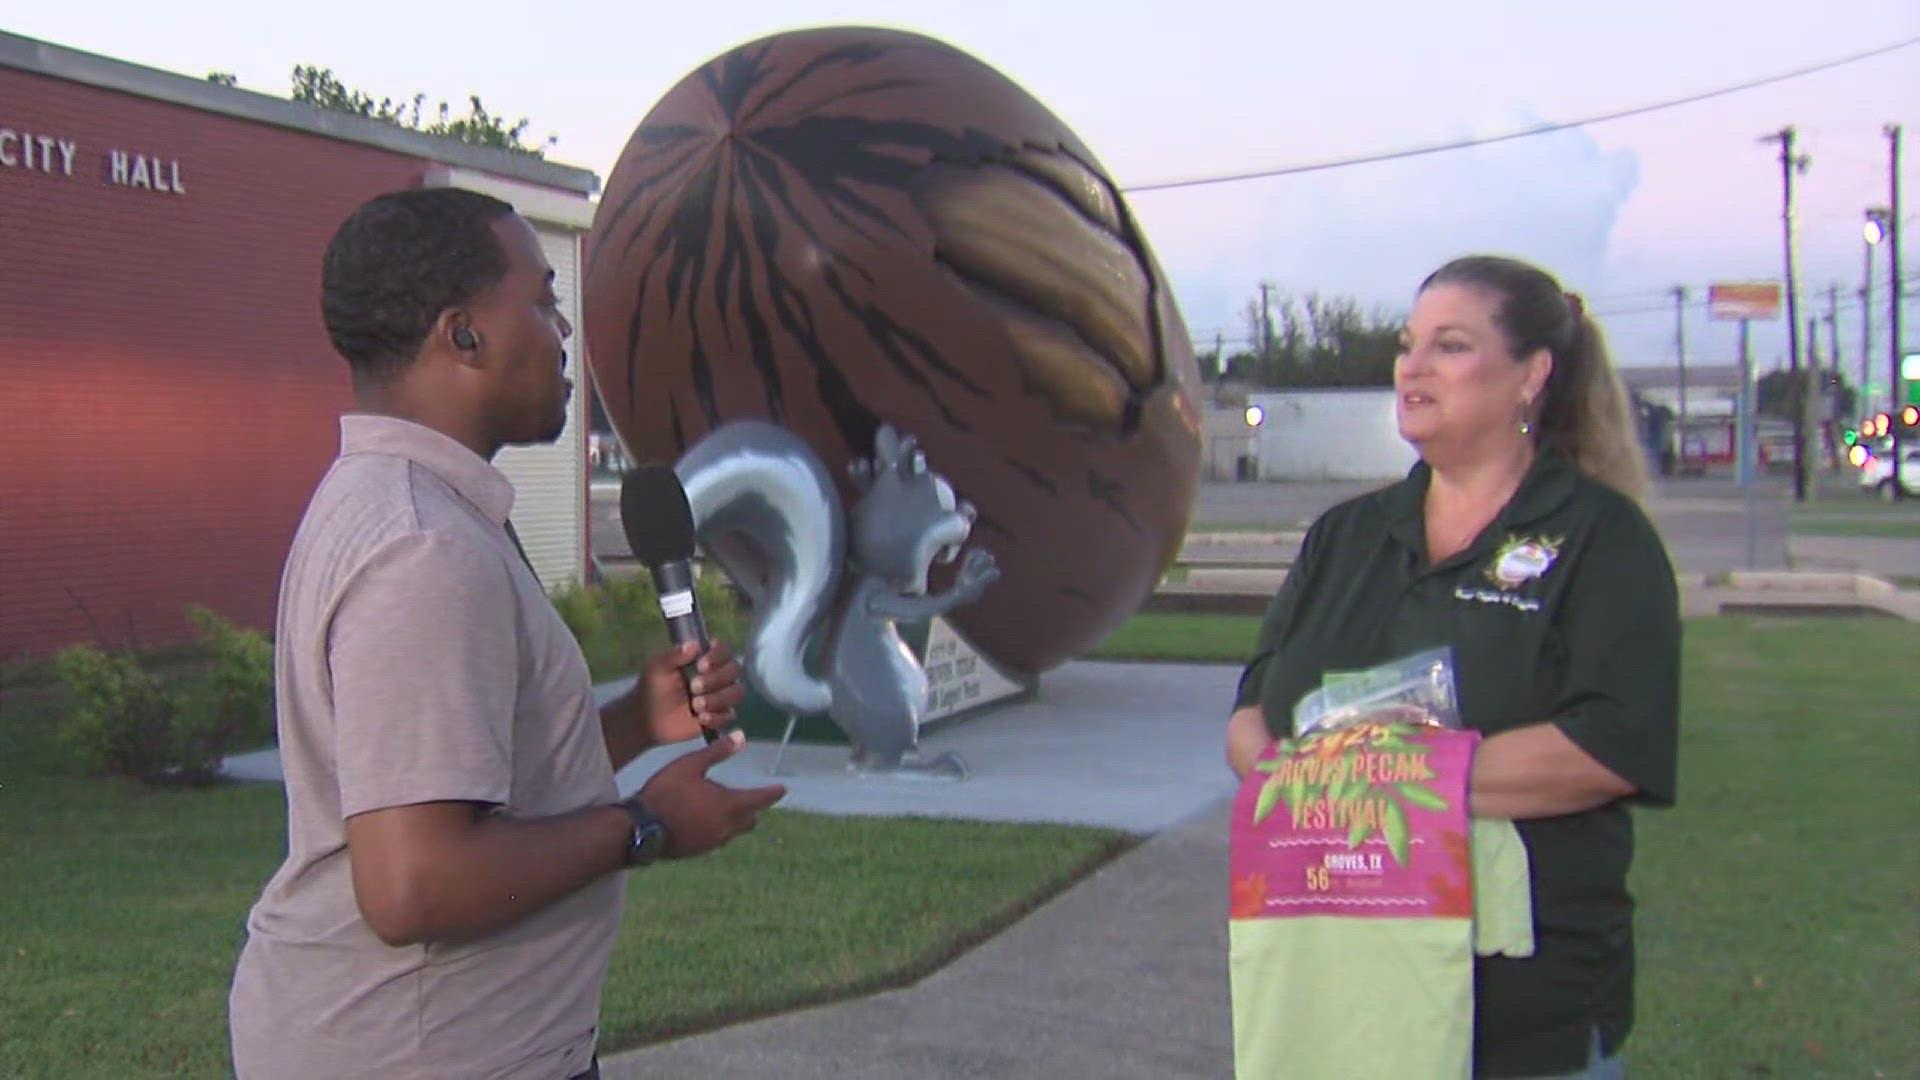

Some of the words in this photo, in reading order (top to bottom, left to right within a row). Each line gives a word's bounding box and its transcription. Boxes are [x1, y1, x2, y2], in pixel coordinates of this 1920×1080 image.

[0, 128, 77, 177] CITY
[110, 149, 187, 195] HALL
[1351, 752, 1427, 784] PECAN
[1305, 867, 1330, 891] 56
